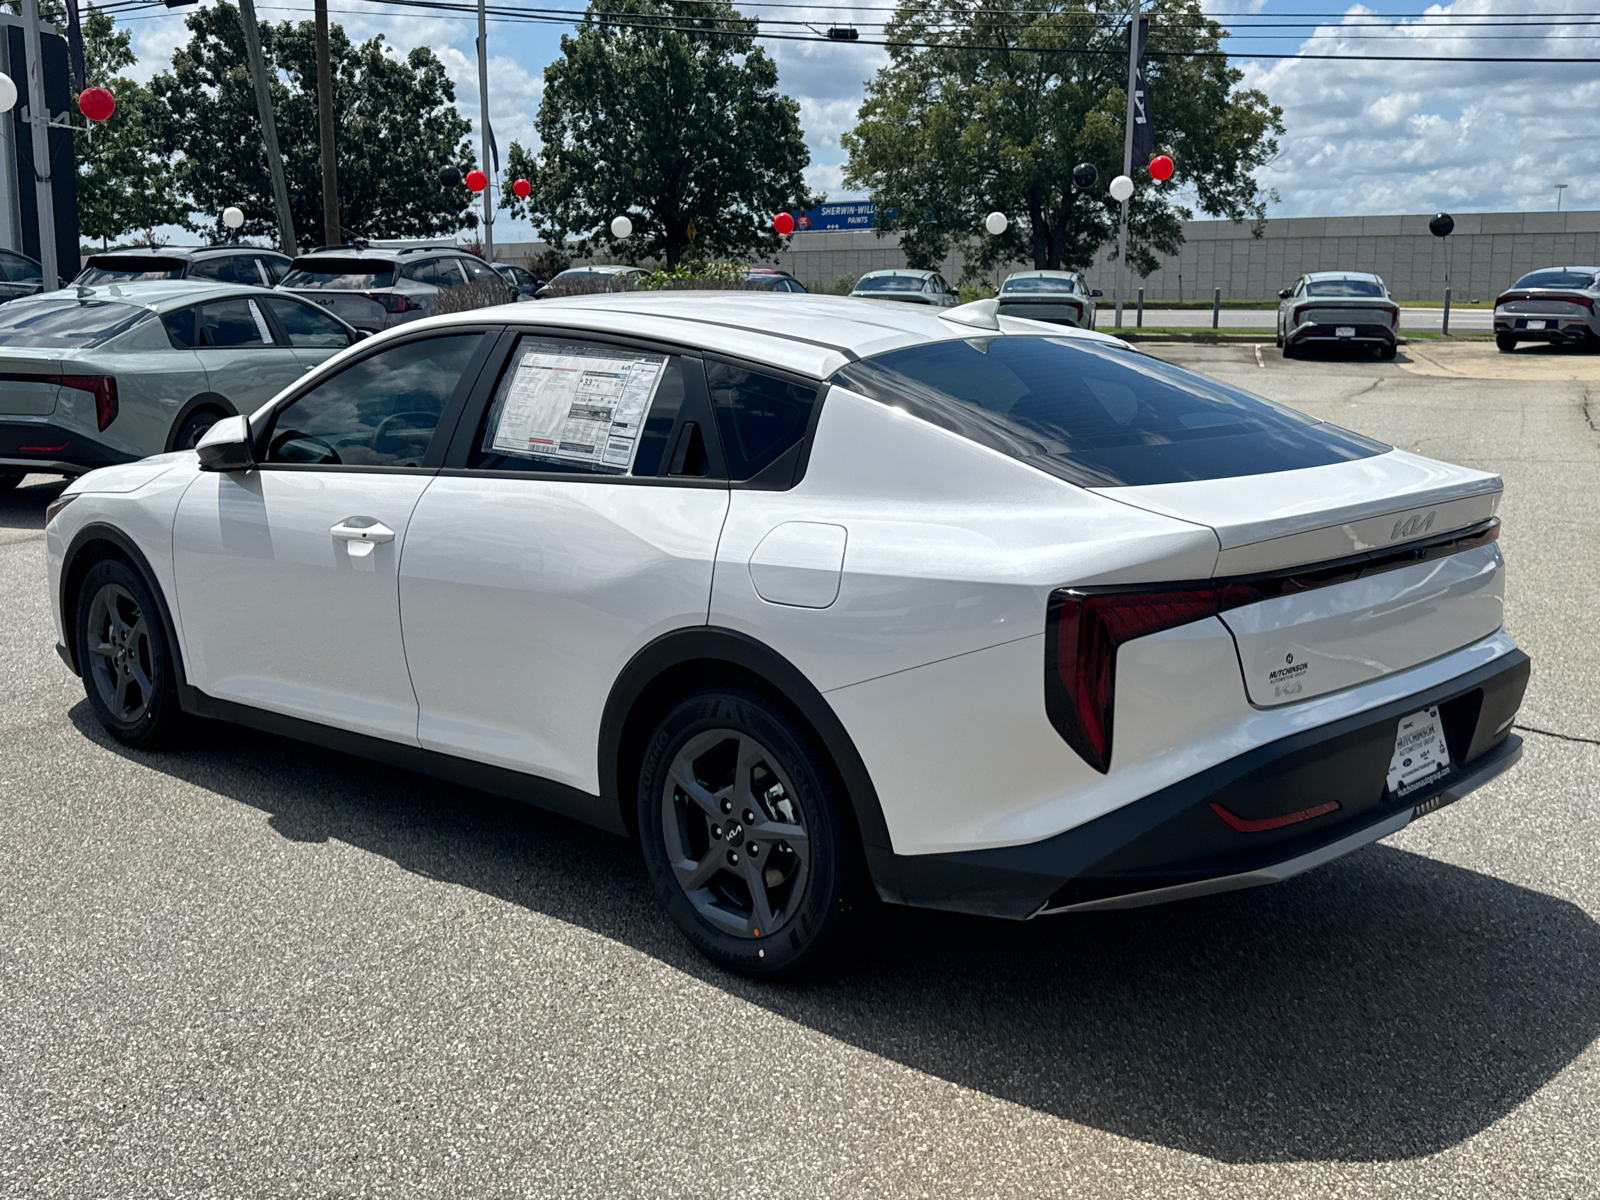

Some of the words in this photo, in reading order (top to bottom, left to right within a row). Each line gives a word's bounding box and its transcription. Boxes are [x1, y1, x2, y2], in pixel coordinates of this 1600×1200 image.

[847, 216, 868, 224] PAINTS
[1391, 511, 1436, 539] KIA
[1269, 662, 1308, 679] HUTCHINSON
[1397, 723, 1435, 750] HUTCHINSON
[1400, 741, 1423, 756] AUTOMOTIVE
[1423, 735, 1435, 746] GROUP
[641, 730, 669, 801] KUMHO
[726, 825, 742, 842] KIA
